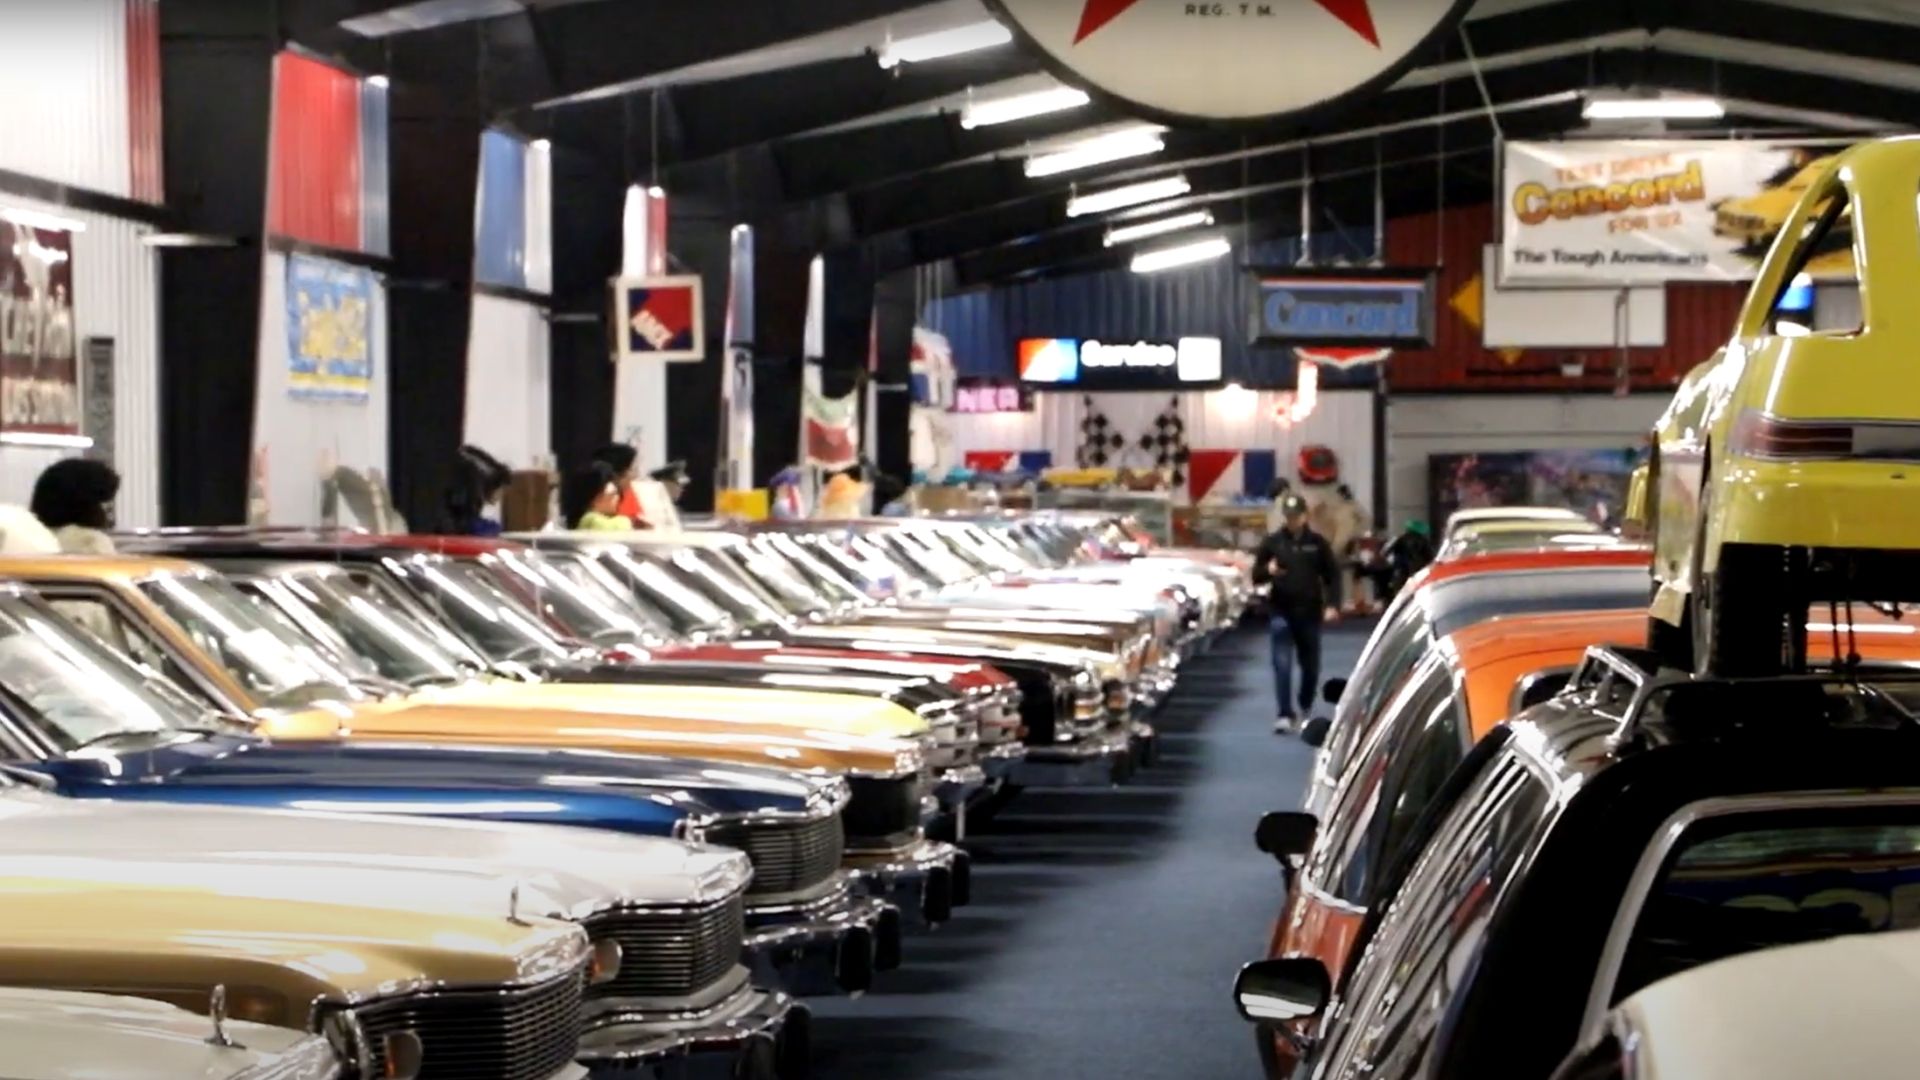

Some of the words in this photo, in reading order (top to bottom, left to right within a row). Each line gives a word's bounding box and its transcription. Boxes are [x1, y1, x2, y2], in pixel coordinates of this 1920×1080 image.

[1185, 3, 1231, 16] REG.
[1513, 159, 1705, 225] Concord
[1514, 248, 1546, 264] The
[1552, 248, 1605, 267] Tough
[1264, 290, 1420, 336] Concord
[1081, 339, 1176, 367] Service
